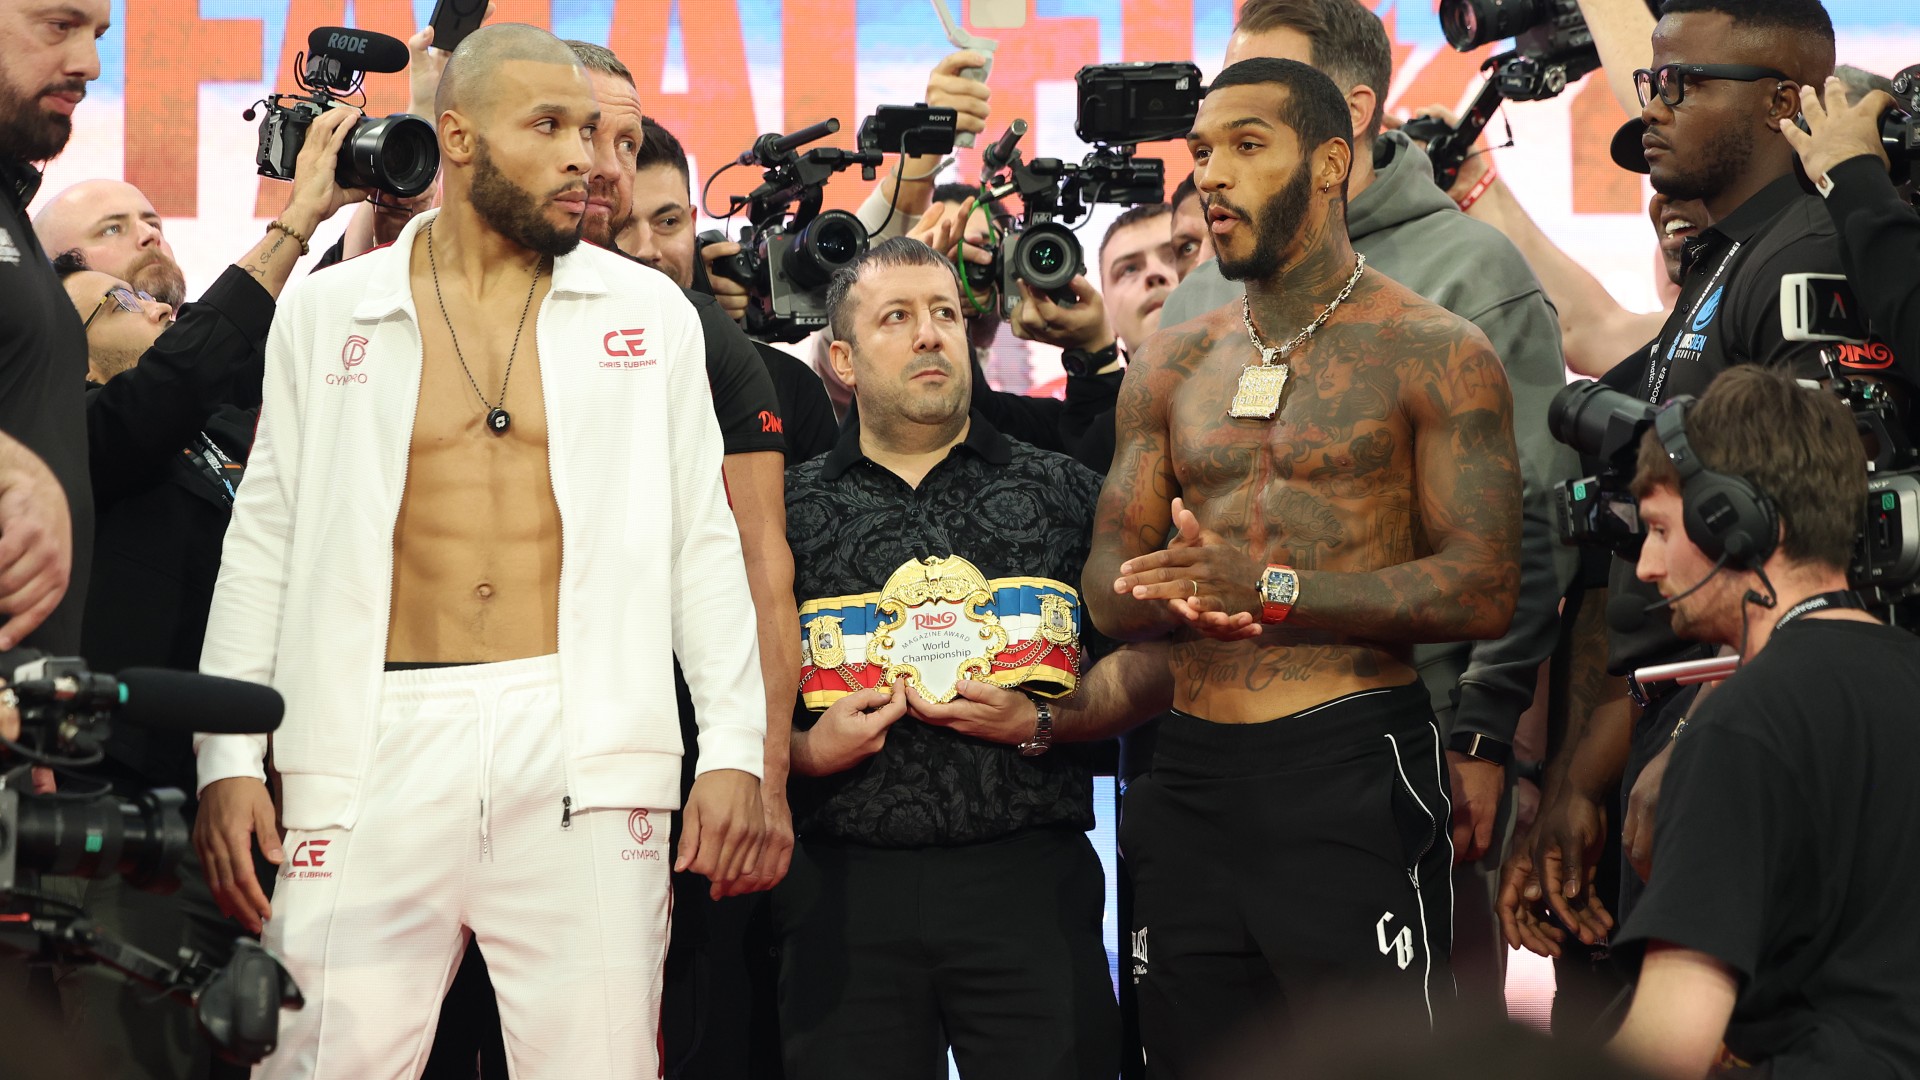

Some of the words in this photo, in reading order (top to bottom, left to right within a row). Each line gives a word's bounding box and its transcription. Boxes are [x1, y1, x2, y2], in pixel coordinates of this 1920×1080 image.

[327, 32, 369, 54] RØDE
[928, 114, 952, 122] SONY
[623, 358, 657, 369] EUBANK
[1649, 366, 1668, 405] BOXXER
[757, 410, 784, 434] RIN
[911, 611, 958, 631] RING
[901, 631, 942, 650] MAGAZINE
[943, 630, 971, 643] AWARD
[922, 640, 951, 652] World
[901, 648, 972, 664] Championship
[621, 849, 660, 861] GYMPRO
[299, 871, 333, 879] EUBANK
